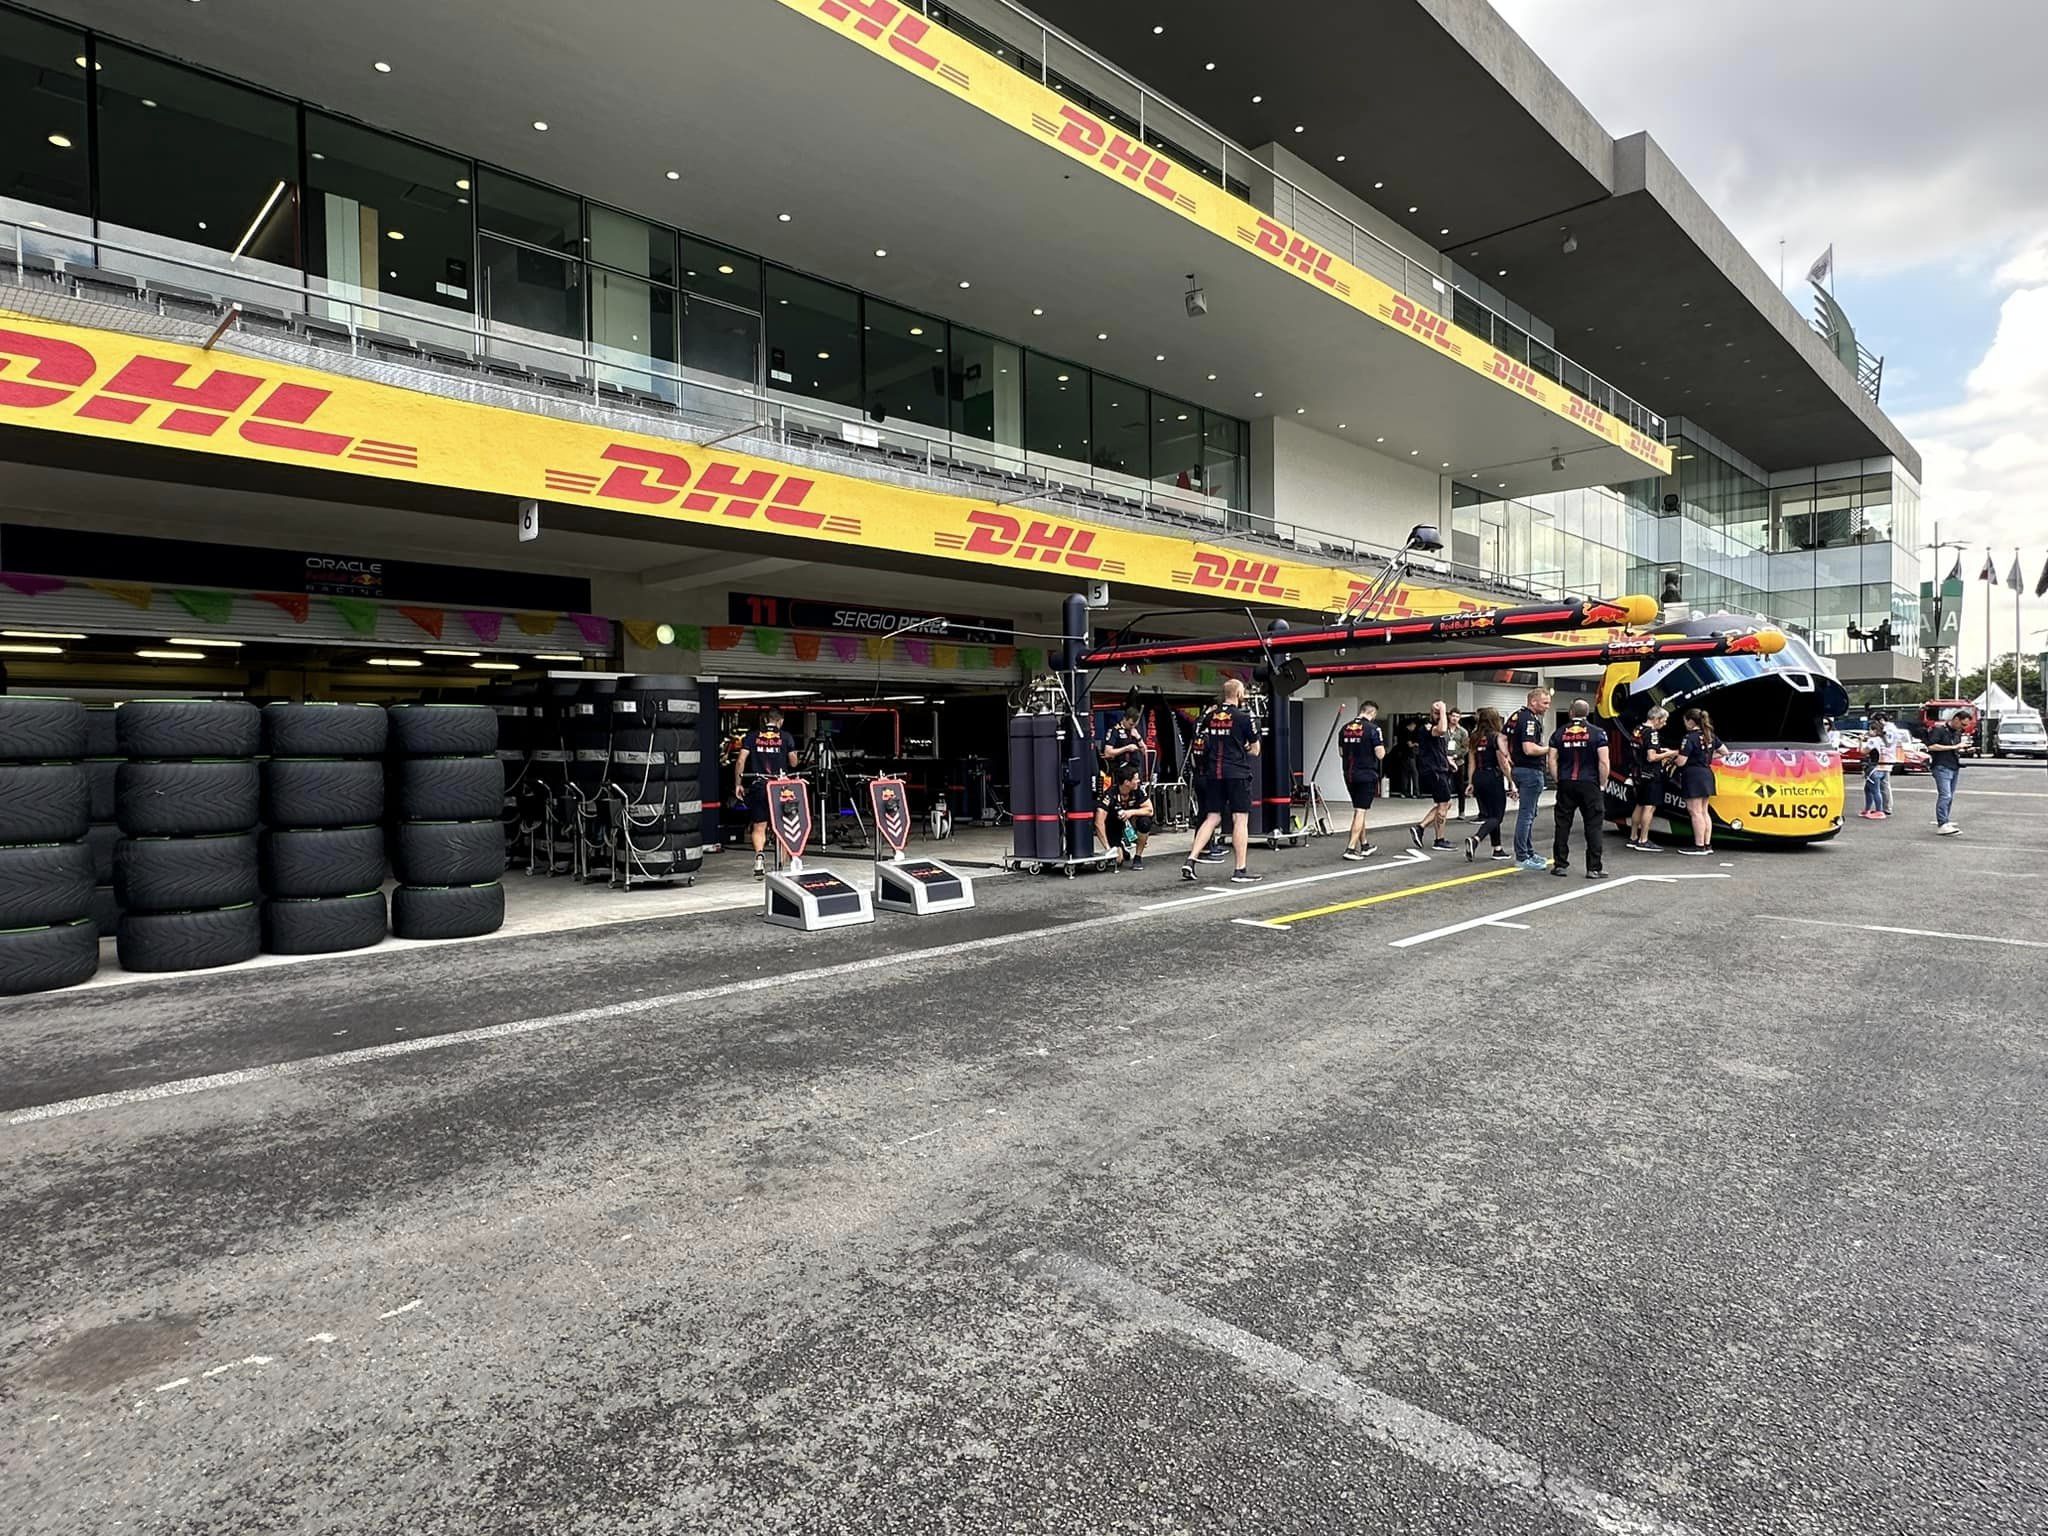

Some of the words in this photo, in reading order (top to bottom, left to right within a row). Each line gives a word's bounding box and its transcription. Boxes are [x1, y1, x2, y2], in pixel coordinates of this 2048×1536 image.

[818, 0, 940, 71] HL
[1058, 105, 1177, 201] DHL
[1254, 216, 1336, 287] DHL
[1391, 294, 1452, 349] DHL
[1491, 352, 1540, 396] DHL
[1569, 396, 1605, 433] DHL
[1629, 431, 1658, 464] DHL
[597, 443, 826, 529] DHL
[524, 508, 532, 530] 6
[965, 510, 1103, 571] DHL
[305, 557, 382, 574] ORACLE
[1193, 552, 1285, 598] DHL
[1094, 586, 1102, 600] 5
[1346, 580, 1413, 618] DHL
[747, 597, 777, 626] 11
[832, 610, 896, 630] SERGIO
[1440, 621, 1454, 630] Red
[1441, 610, 1497, 621] ORACLE
[1920, 613, 1932, 632] A
[1943, 611, 1959, 631] A
[1748, 803, 1828, 819] JALISCO
